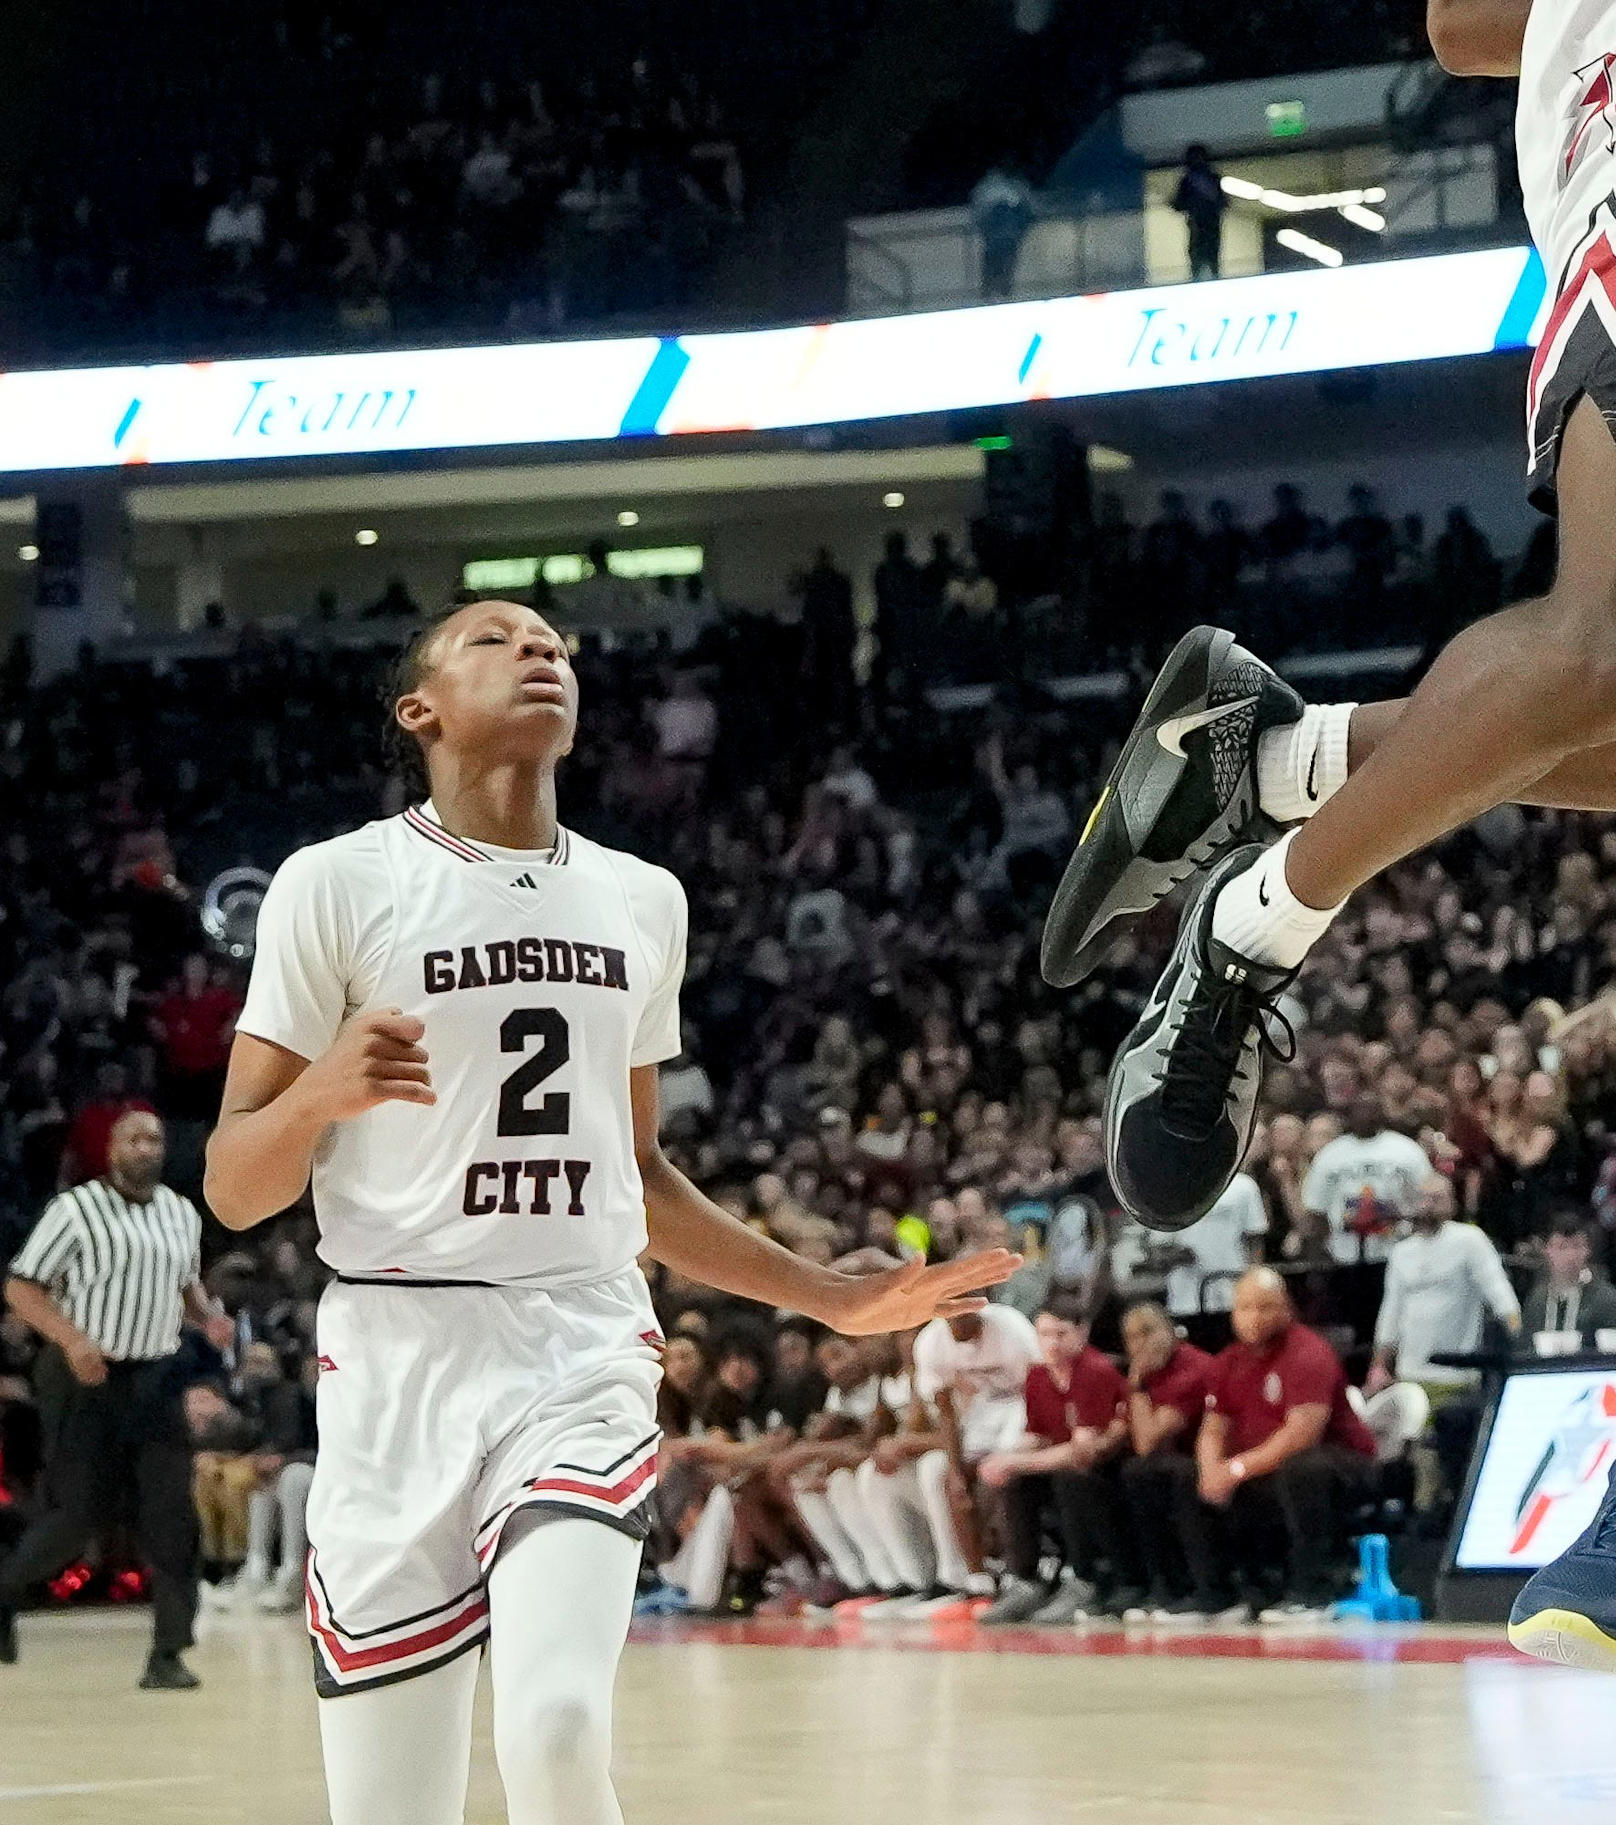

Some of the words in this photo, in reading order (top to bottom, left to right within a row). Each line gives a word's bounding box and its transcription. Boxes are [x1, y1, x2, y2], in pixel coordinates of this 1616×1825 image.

[1127, 307, 1299, 369] Team
[232, 379, 417, 439] Team
[423, 937, 630, 995] GADSDEN
[496, 1007, 570, 1138] 2
[463, 1159, 591, 1217] CITY
